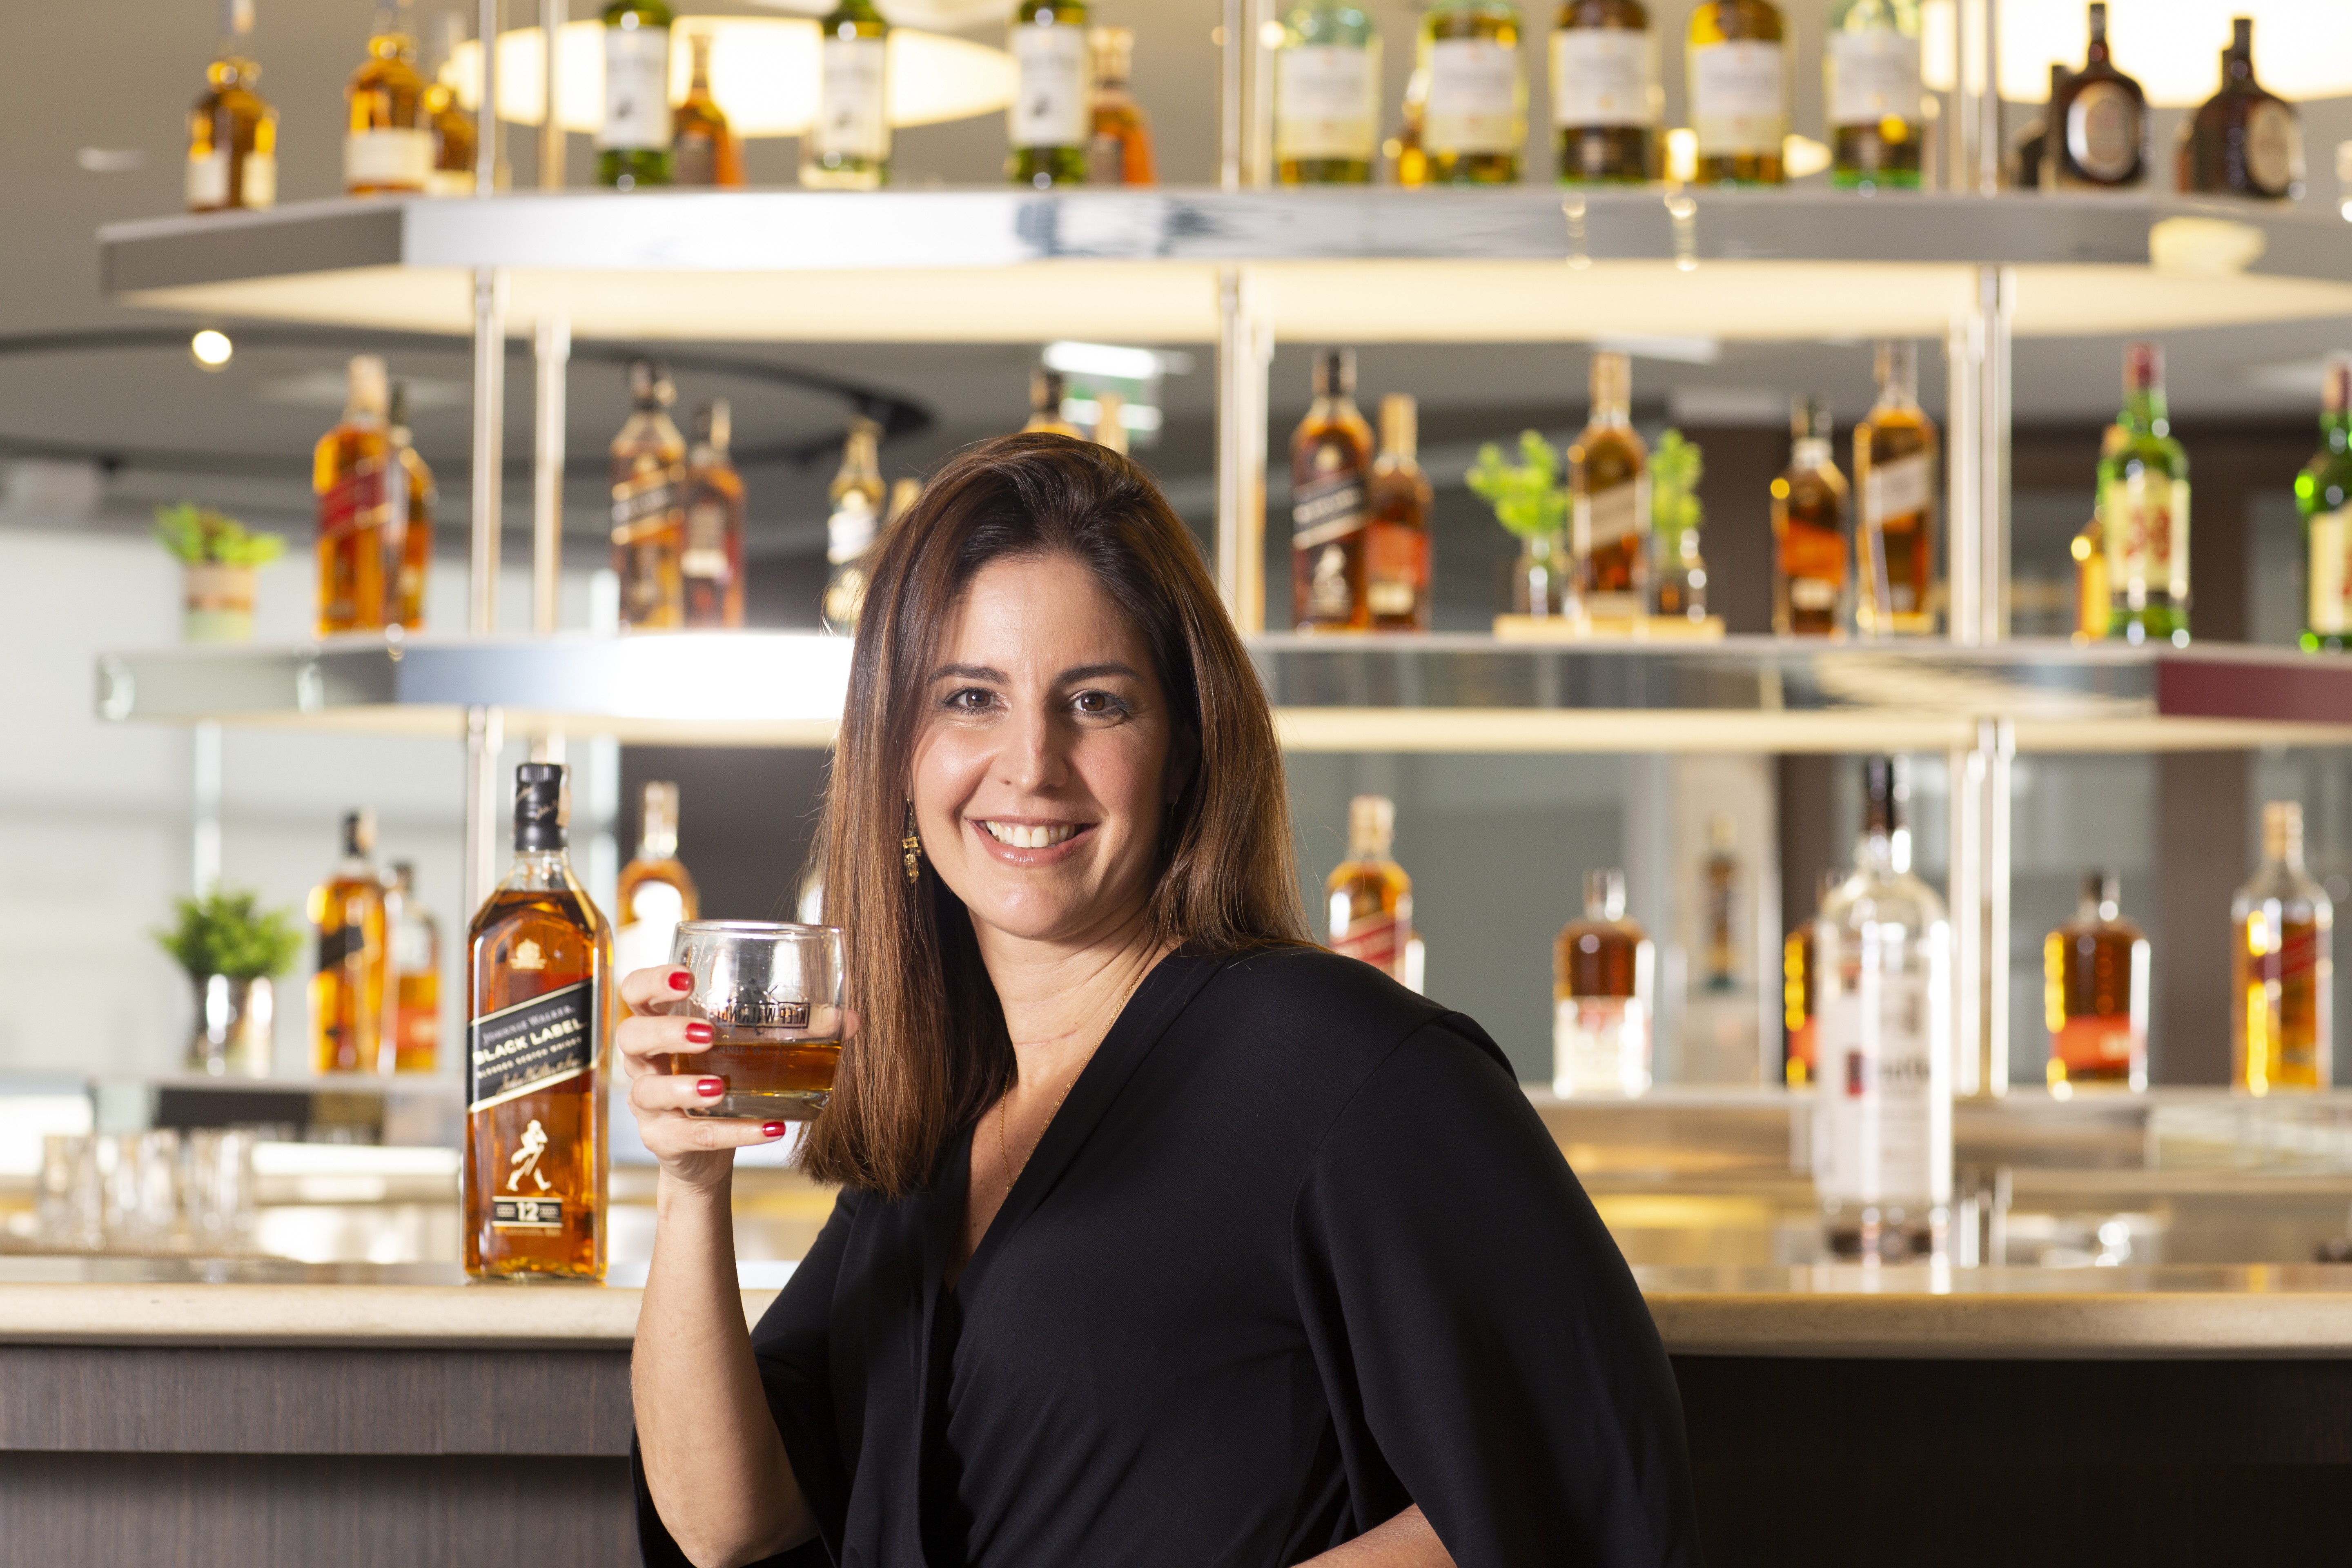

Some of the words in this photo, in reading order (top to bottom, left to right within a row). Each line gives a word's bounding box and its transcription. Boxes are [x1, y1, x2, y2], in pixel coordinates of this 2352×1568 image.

[472, 1035, 528, 1066] BLACK
[529, 1017, 584, 1045] LABEL
[516, 1202, 539, 1222] 12
